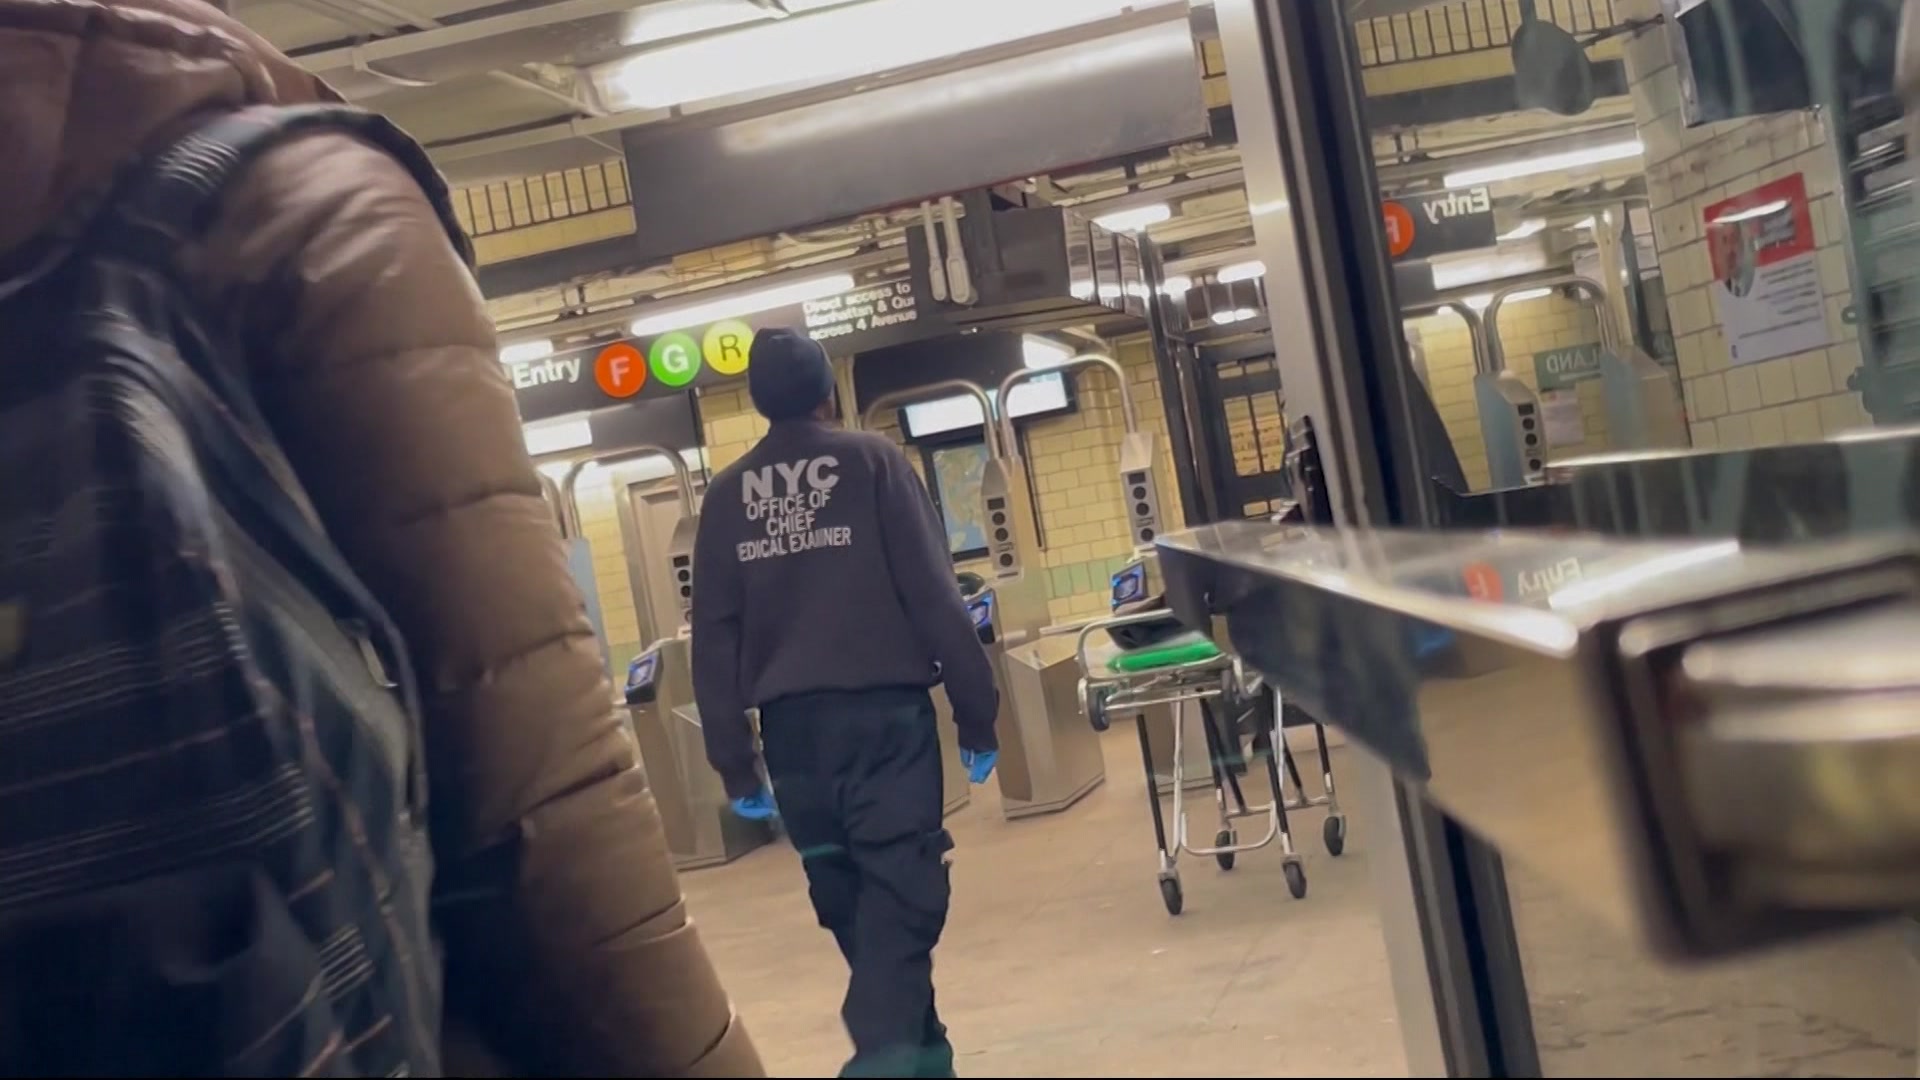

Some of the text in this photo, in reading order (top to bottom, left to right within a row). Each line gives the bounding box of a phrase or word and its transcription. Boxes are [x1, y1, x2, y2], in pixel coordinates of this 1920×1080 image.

[845, 286, 893, 305] access
[896, 282, 911, 295] to
[511, 333, 742, 389] Entry F G R
[742, 455, 840, 504] NYC
[746, 487, 832, 521] OFFICE OF
[766, 510, 816, 537] CHIEF
[736, 537, 788, 562] EDICAL
